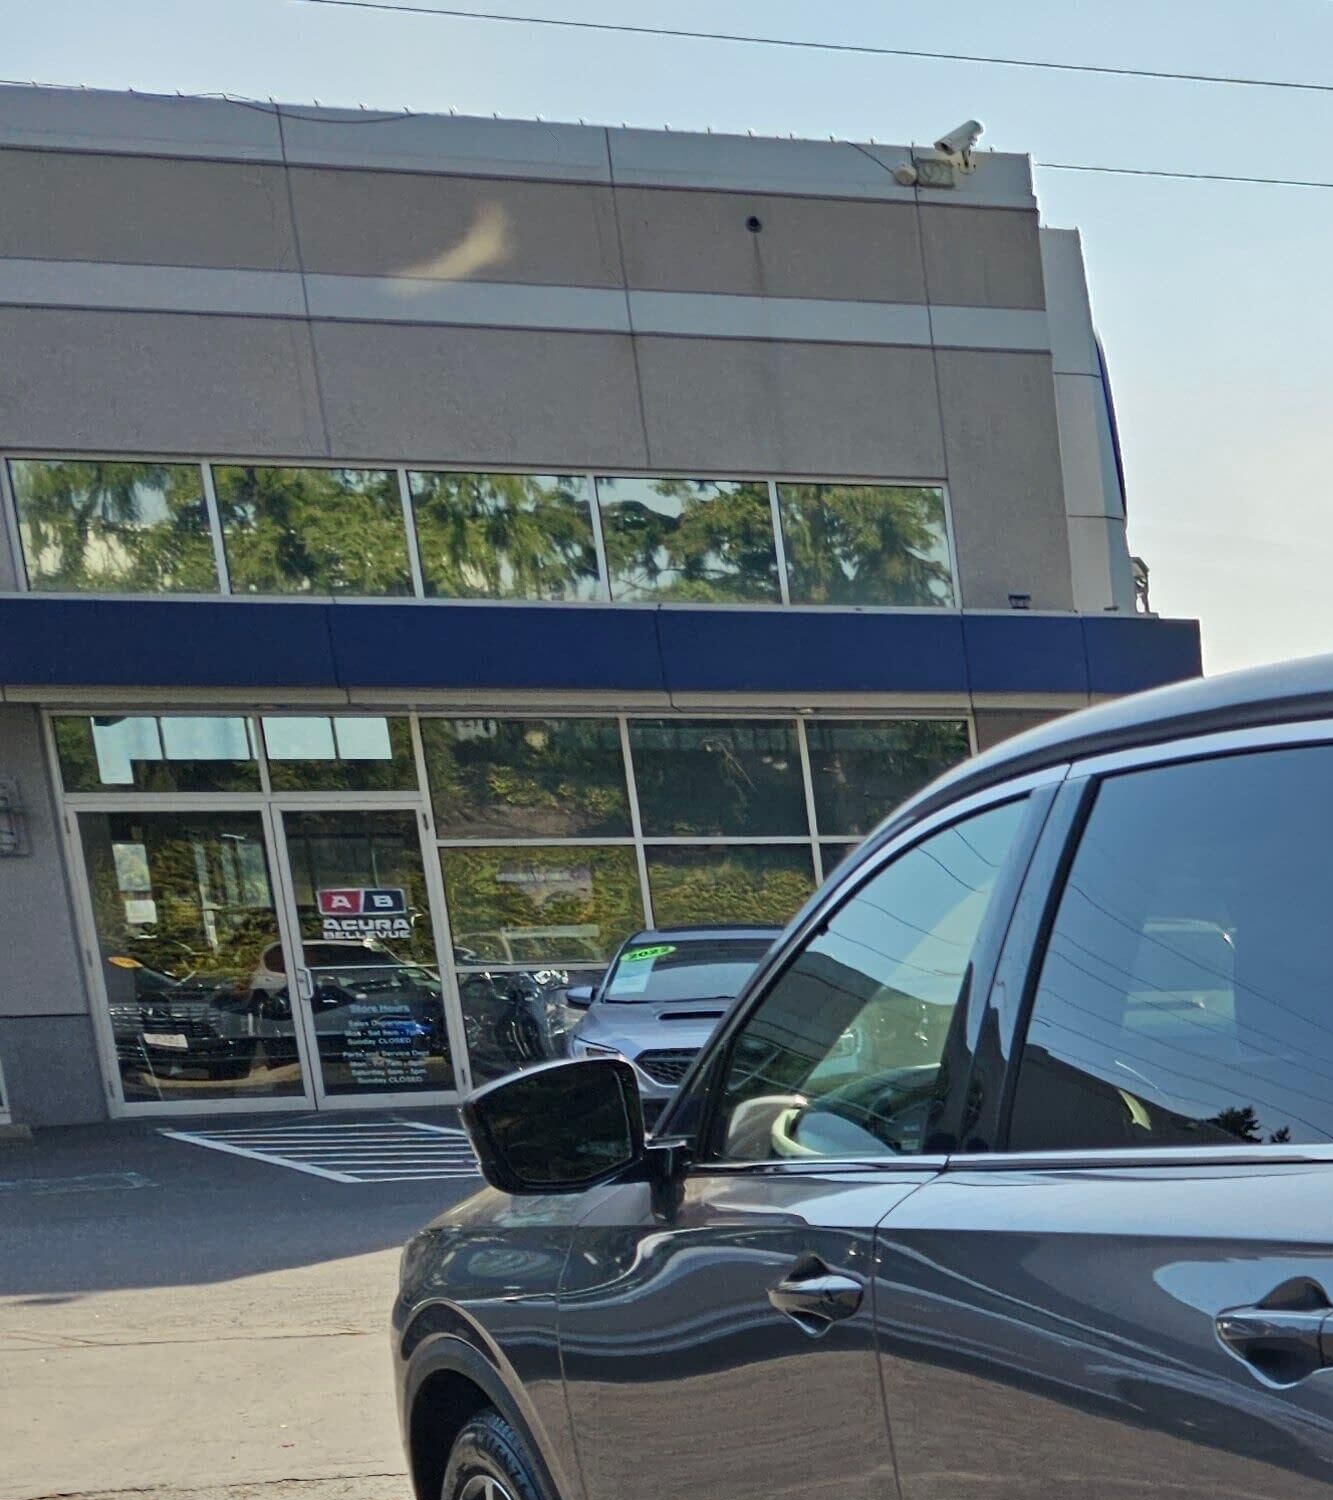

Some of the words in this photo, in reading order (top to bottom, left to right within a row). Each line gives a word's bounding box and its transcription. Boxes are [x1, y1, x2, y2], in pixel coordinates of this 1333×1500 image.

[330, 895, 352, 908] A
[372, 895, 394, 908] B
[323, 918, 410, 930] ACURA
[323, 930, 411, 940] BELLEVUE
